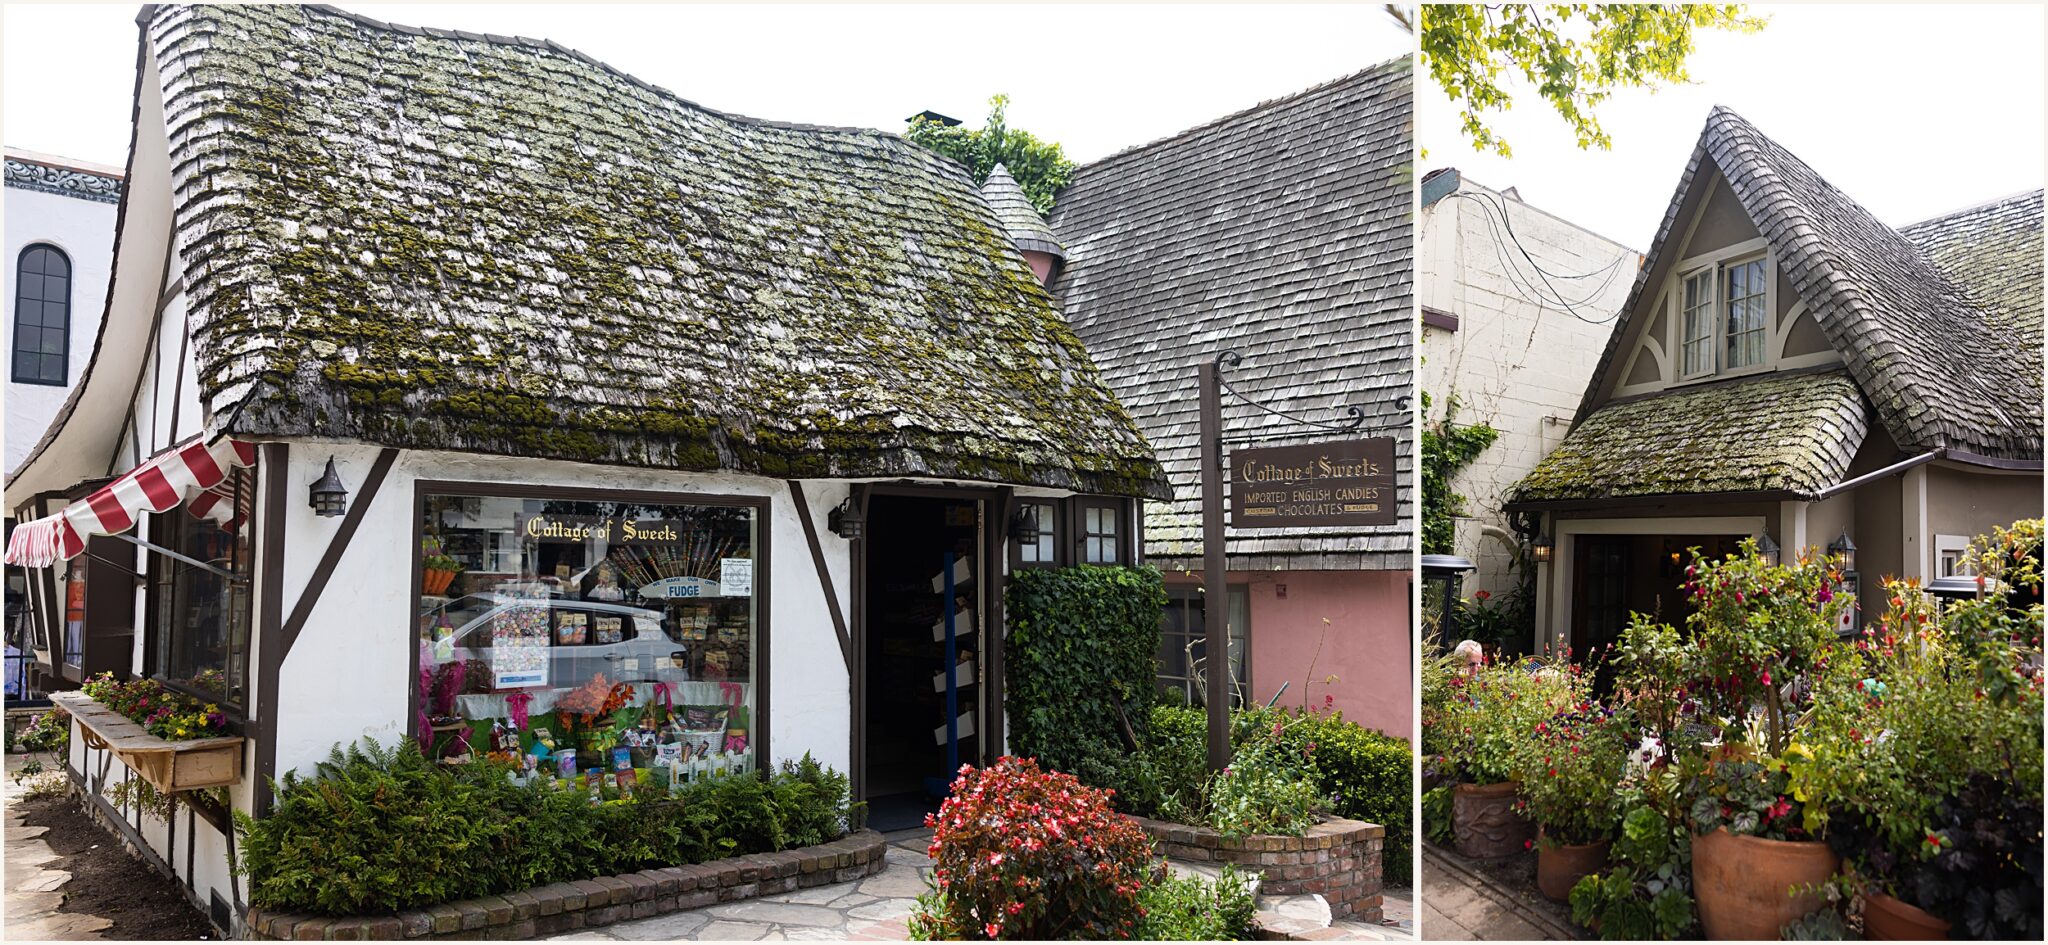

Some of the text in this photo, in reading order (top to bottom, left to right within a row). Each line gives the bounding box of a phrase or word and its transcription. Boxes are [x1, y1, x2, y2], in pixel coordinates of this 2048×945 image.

[1243, 454, 1380, 488] Cottage of Sweets
[1244, 487, 1379, 504] IMPORTED ENGLISH CANDIES
[1277, 503, 1343, 516] CHOCOLATES
[527, 516, 678, 543] Cottage of Sweets
[669, 585, 700, 597] FUDGE
